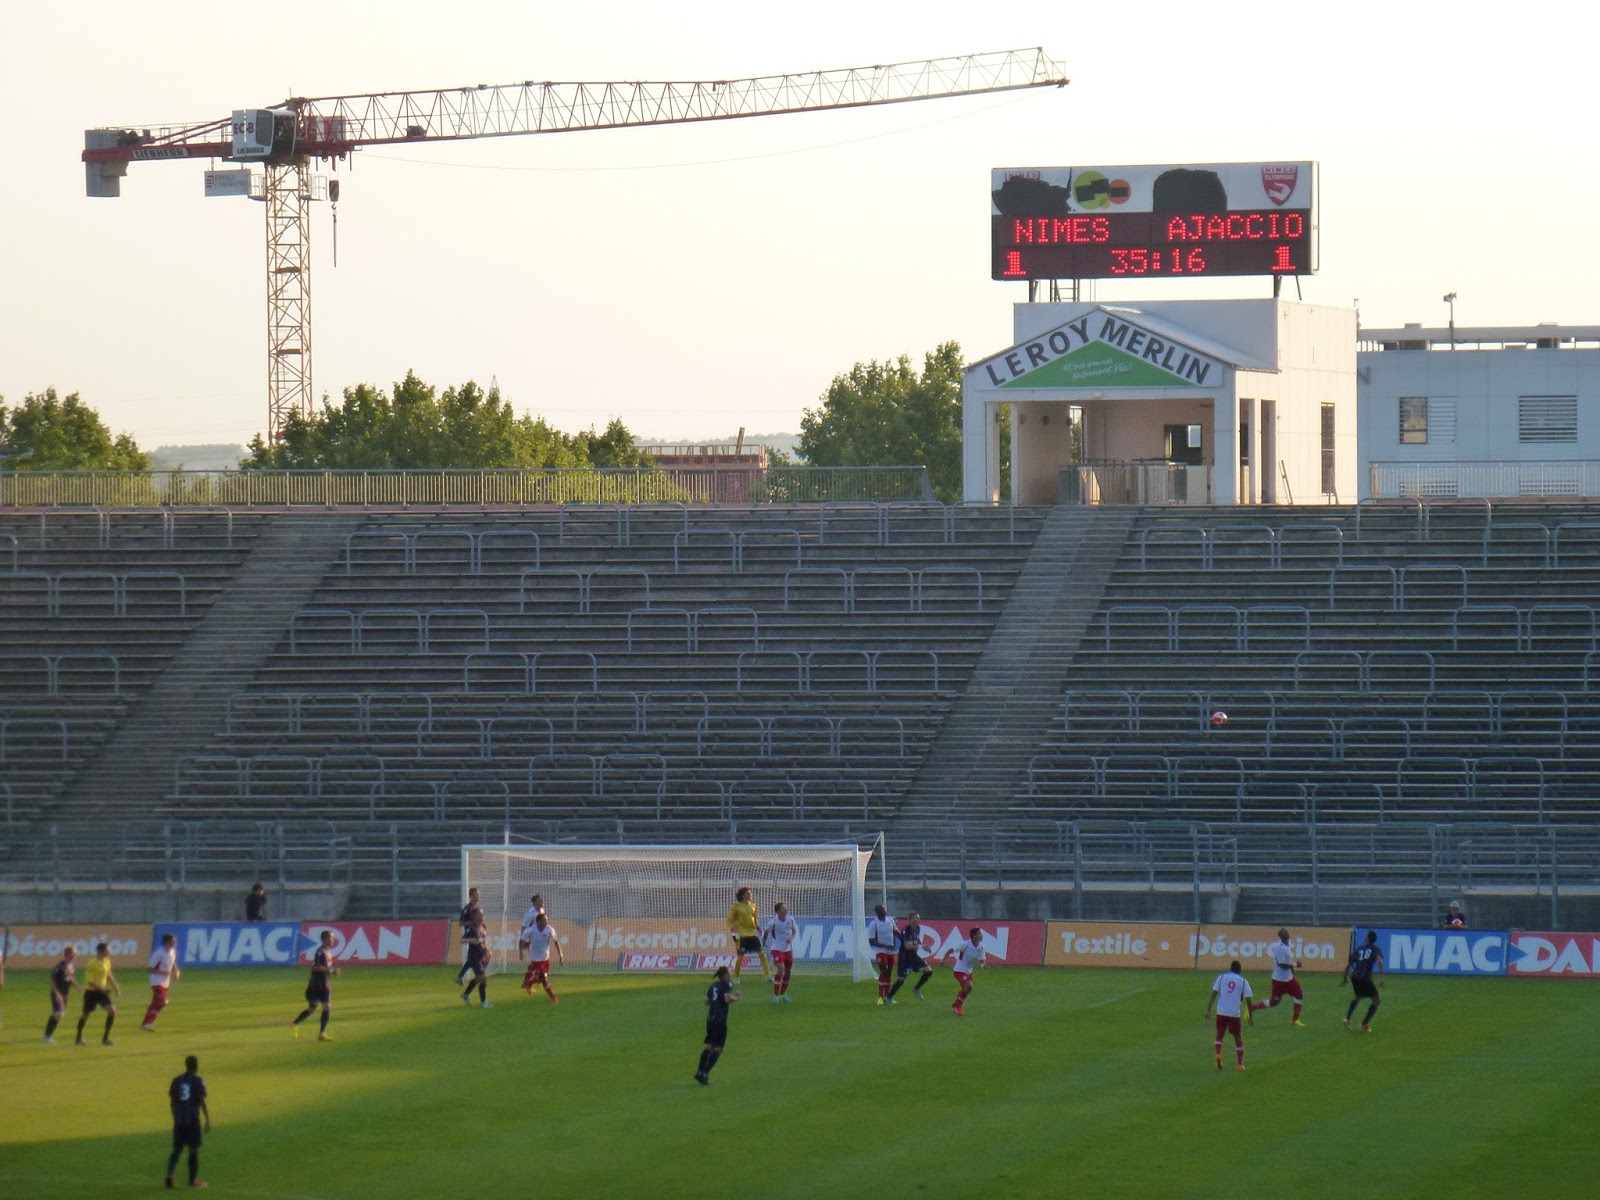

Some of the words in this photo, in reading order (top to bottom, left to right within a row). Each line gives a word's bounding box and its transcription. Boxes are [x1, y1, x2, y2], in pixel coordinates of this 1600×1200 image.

[135, 148, 184, 159] LIEBHERR
[1014, 217, 1110, 243] NIMES
[1167, 213, 1303, 241] AJACCIO
[1003, 251, 1027, 275] 1
[1111, 248, 1206, 273] 35:16
[1272, 246, 1296, 270] 1
[986, 317, 1091, 387] LEROY
[1099, 316, 1211, 385] MERLIN
[185, 927, 293, 962] MAC
[305, 926, 412, 960] DAN
[587, 928, 727, 950] Décoration
[1061, 932, 1148, 956] Textile
[629, 954, 670, 968] RMC
[1389, 935, 1501, 972] MAC
[1228, 981, 1236, 994] 9
[180, 1083, 191, 1101] 3
